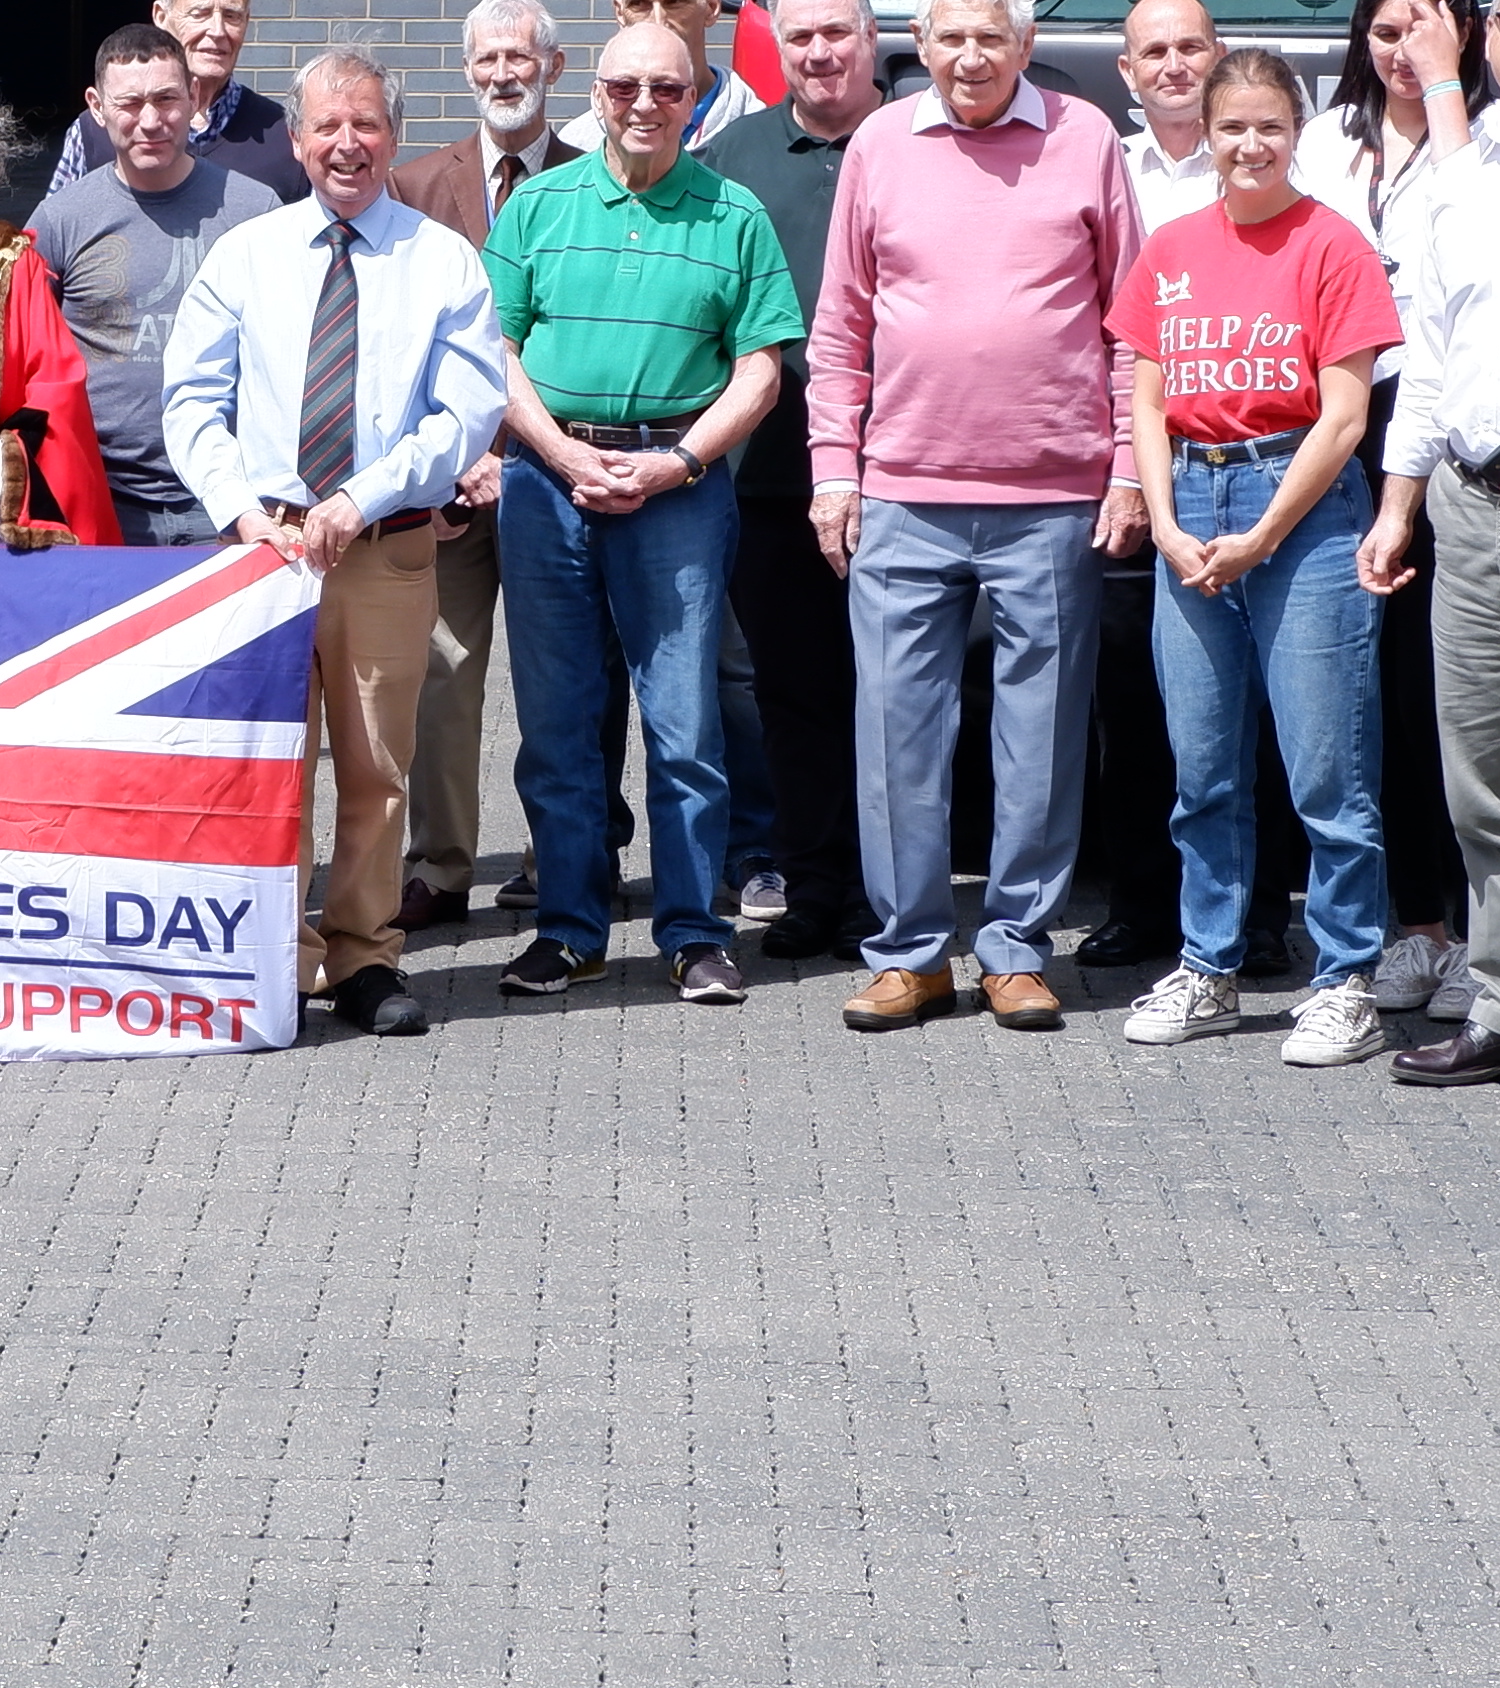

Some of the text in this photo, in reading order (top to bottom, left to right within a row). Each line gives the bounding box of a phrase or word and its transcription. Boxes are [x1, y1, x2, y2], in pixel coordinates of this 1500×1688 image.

[1159, 312, 1302, 356] HELP for
[1162, 357, 1301, 399] HEROES
[105, 890, 253, 954] DAY
